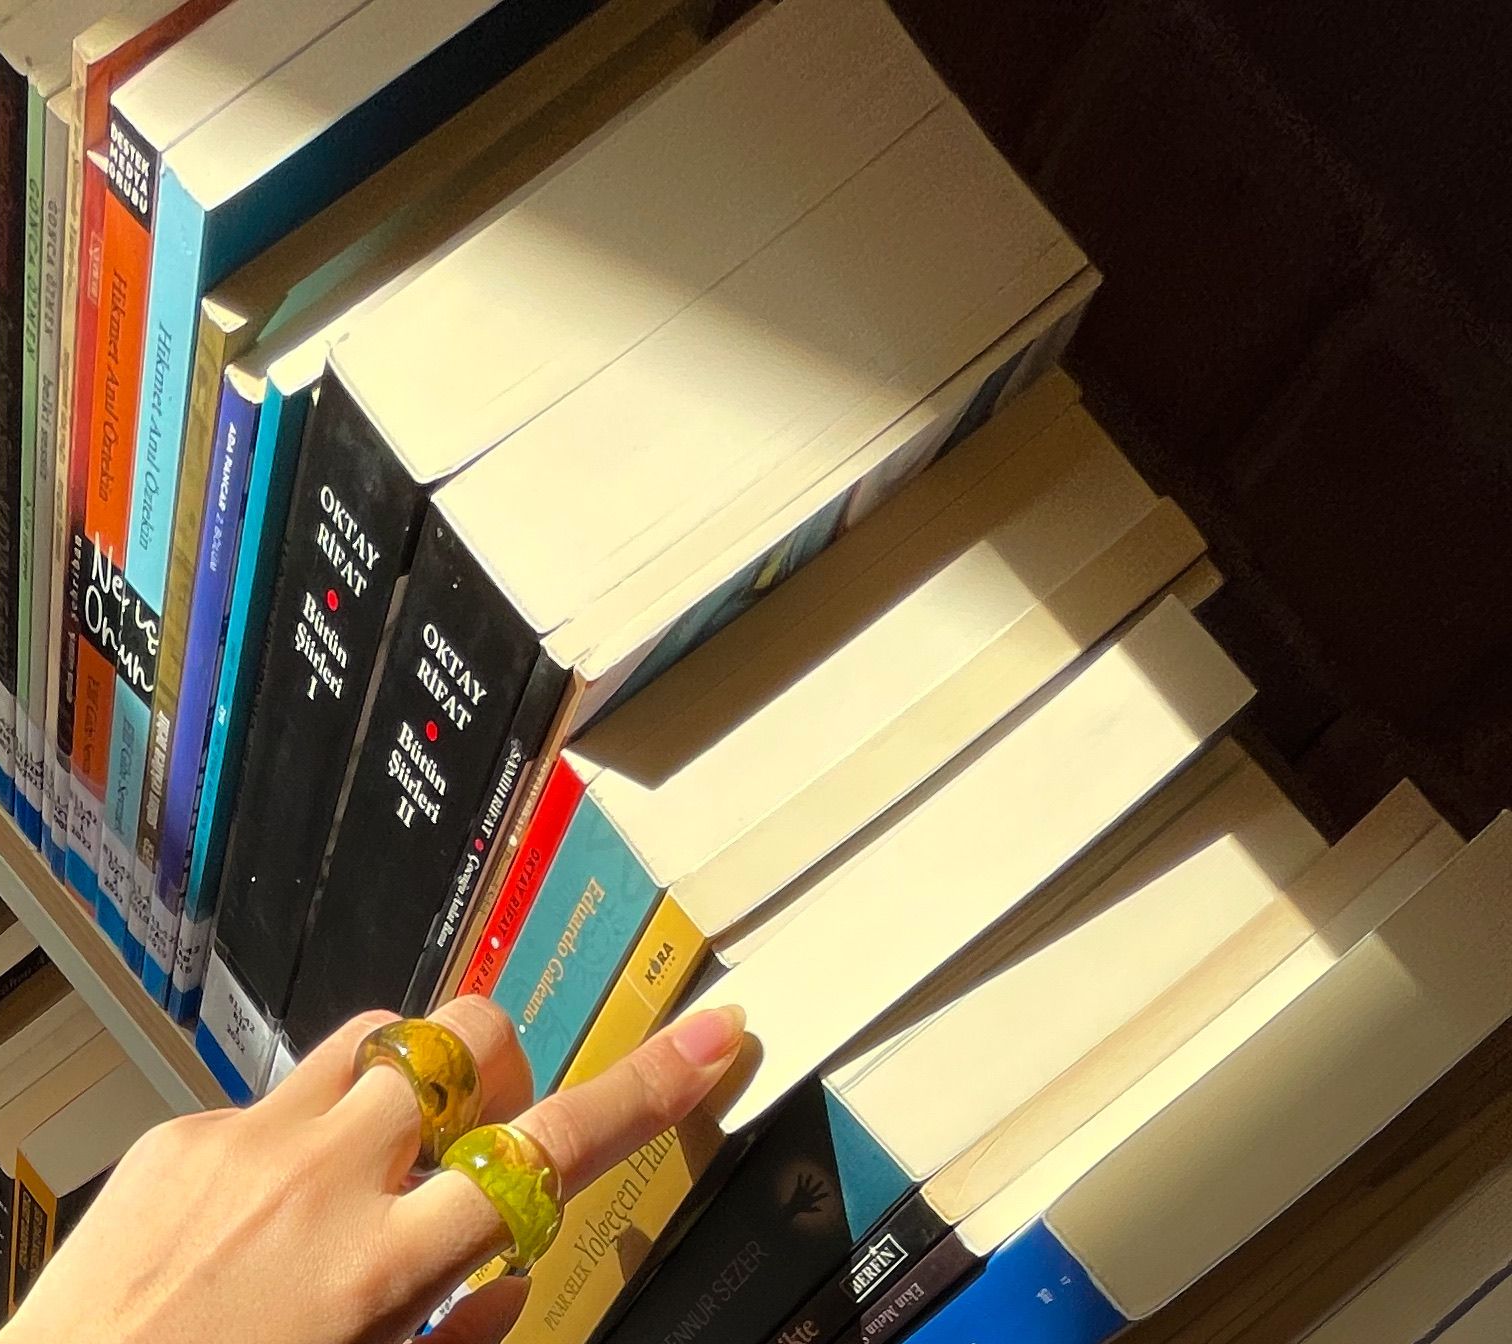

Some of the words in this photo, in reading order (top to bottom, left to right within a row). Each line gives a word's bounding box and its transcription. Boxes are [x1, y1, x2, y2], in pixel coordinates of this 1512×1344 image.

[109, 142, 149, 196] MEDYA
[110, 121, 151, 178] DESTEK
[26, 177, 41, 265] GONCA
[108, 160, 148, 215] GRUBU
[45, 199, 60, 267] GONCA
[316, 521, 368, 598] RİFAT
[319, 484, 381, 571] OKTAY
[294, 621, 344, 700] Şiirleri
[302, 590, 349, 670] Bütün
[306, 673, 319, 701] I
[415, 656, 472, 732] RİFAT
[422, 622, 488, 707] OKTAY
[387, 748, 441, 825] Şiirleri
[396, 720, 448, 797] Bütün
[395, 794, 416, 829] II
[517, 847, 542, 891] OKTAY
[498, 889, 522, 937] RİFAT
[556, 876, 606, 958] Eduardo
[522, 957, 565, 1025] Galeano
[574, 1177, 644, 1266] Yolgeçen
[563, 1259, 592, 1301] SELEK
[710, 1239, 770, 1301] SEZER
[899, 1281, 926, 1307] Ekin
[544, 1291, 573, 1331] PINAR
[864, 1304, 900, 1339] Metin
